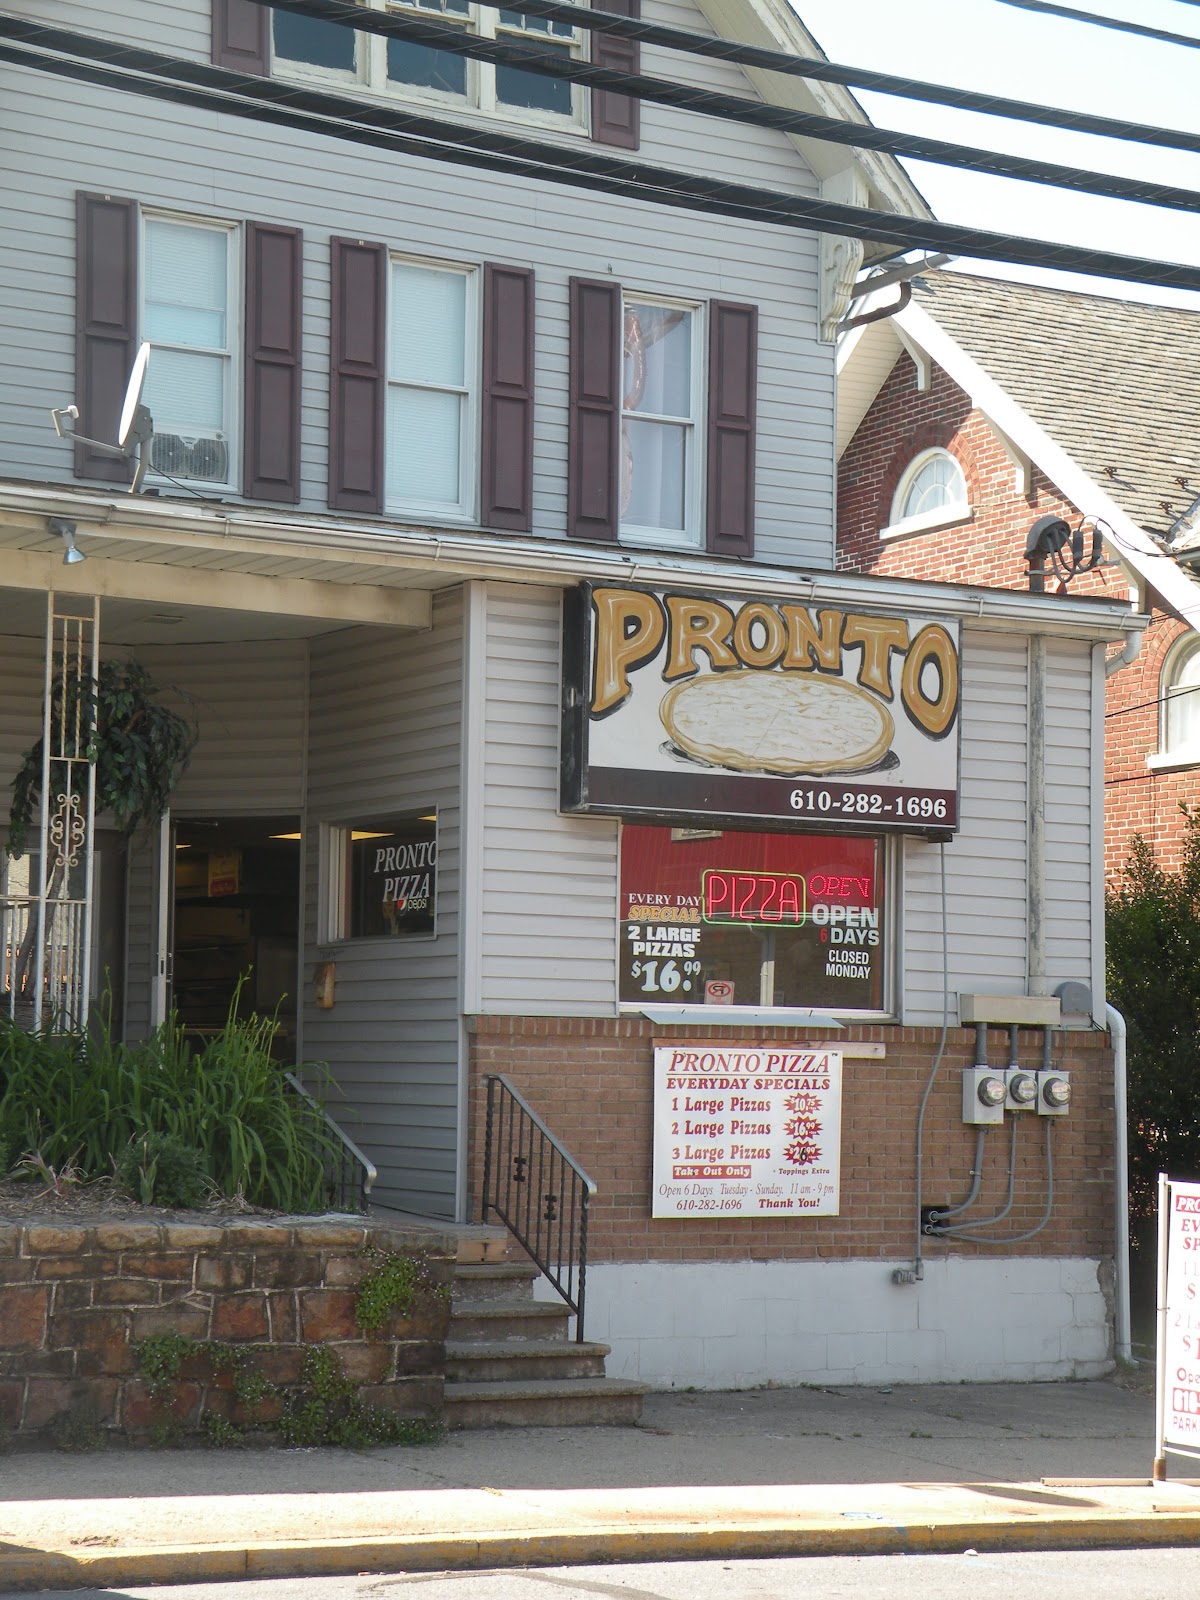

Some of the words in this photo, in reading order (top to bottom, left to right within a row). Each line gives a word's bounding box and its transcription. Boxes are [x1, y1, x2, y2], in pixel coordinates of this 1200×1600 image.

[591, 588, 959, 741] PRONTO
[789, 789, 947, 819] 610-282-1696
[374, 840, 437, 873] PRONTO
[382, 872, 430, 902] PIZZA
[808, 875, 871, 898] OPEN
[628, 893, 674, 905] EVERY
[676, 895, 700, 907] DAY
[708, 875, 799, 922] PIZZA
[628, 905, 701, 923] SPECIAL
[812, 903, 879, 928] OPEN
[628, 926, 640, 940] 2
[647, 926, 701, 942] LARGE
[820, 930, 827, 943] 6
[831, 927, 879, 946] DAYS
[633, 941, 695, 958] PIZZAS
[828, 950, 869, 965] CLOSED
[631, 960, 701, 992] $16.99
[825, 963, 871, 979] MONDAY
[668, 1052, 761, 1072] PRONTO
[765, 1054, 829, 1073] PIZZA
[666, 1078, 750, 1090] EVERYDAY
[754, 1078, 830, 1090] SPECIALS
[672, 1098, 678, 1111] 1
[685, 1097, 724, 1115] Large
[730, 1097, 771, 1112] Pizzas
[672, 1122, 679, 1135] 2
[685, 1120, 724, 1138] Large
[730, 1120, 771, 1135] Pizzas
[672, 1147, 680, 1160] 3
[685, 1145, 724, 1163] Large
[730, 1145, 771, 1160] Pizzas
[674, 1166, 699, 1177] Take
[703, 1167, 722, 1176] Out
[726, 1166, 750, 1177] Only
[659, 1183, 682, 1198] Open
[684, 1184, 689, 1195] 6
[692, 1183, 713, 1197] Days
[720, 1183, 748, 1197] Tuesday
[790, 1183, 798, 1194] 11
[800, 1186, 811, 1194] am
[817, 1183, 823, 1194] 9
[823, 1186, 834, 1198] pm
[676, 1199, 742, 1210] 610-282-1696
[758, 1199, 794, 1209] Thank
[797, 1198, 821, 1208] You!
